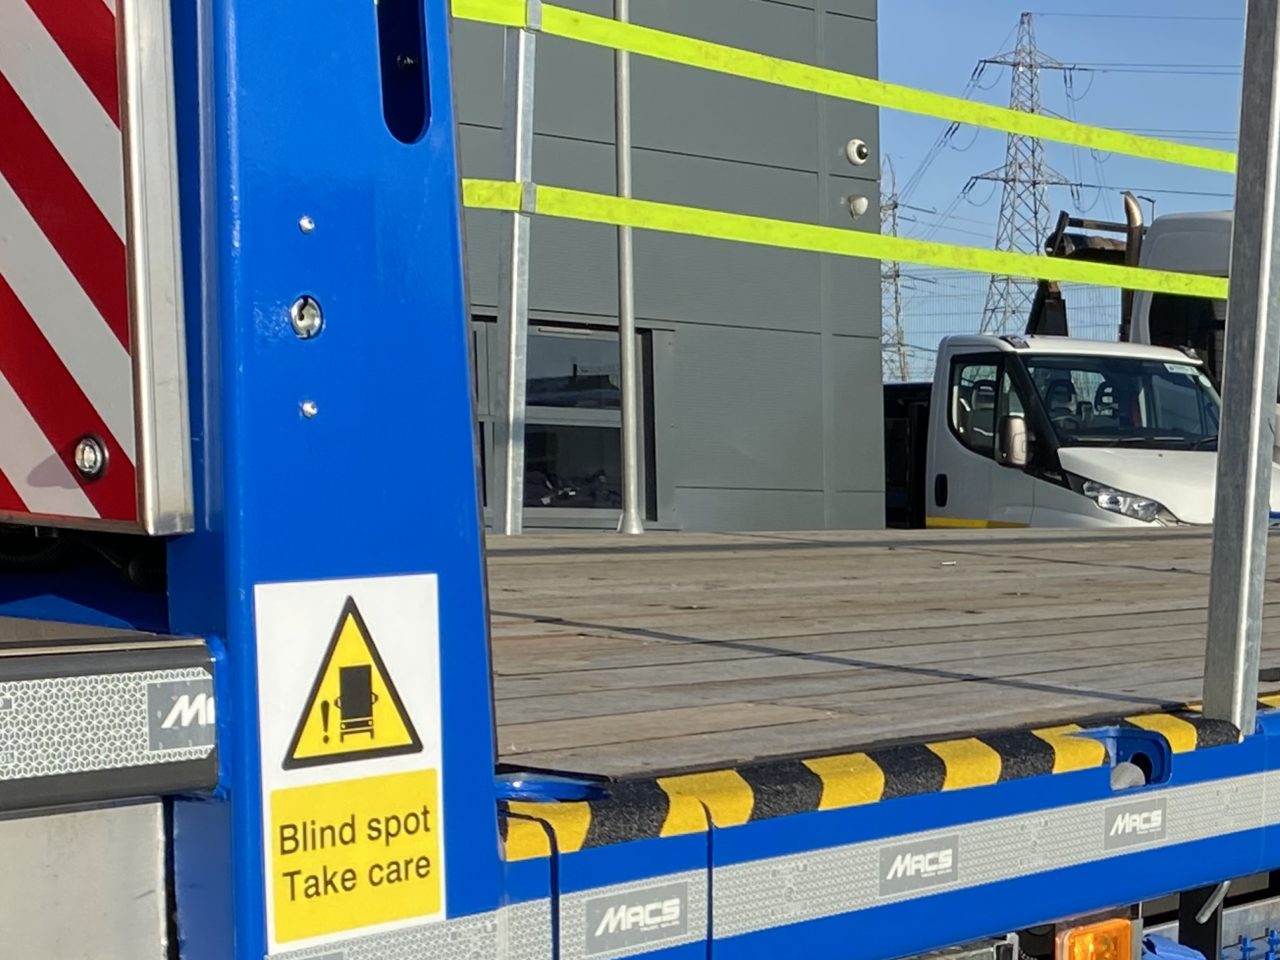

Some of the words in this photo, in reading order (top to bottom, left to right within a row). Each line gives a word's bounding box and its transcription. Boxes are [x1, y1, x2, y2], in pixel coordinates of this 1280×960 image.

[280, 814, 356, 856] Blind
[367, 805, 431, 847] spot
[1109, 809, 1163, 836] MACS
[282, 865, 357, 902] Take
[368, 856, 431, 887] care
[886, 849, 953, 880] MACS
[594, 898, 680, 937] MACS
